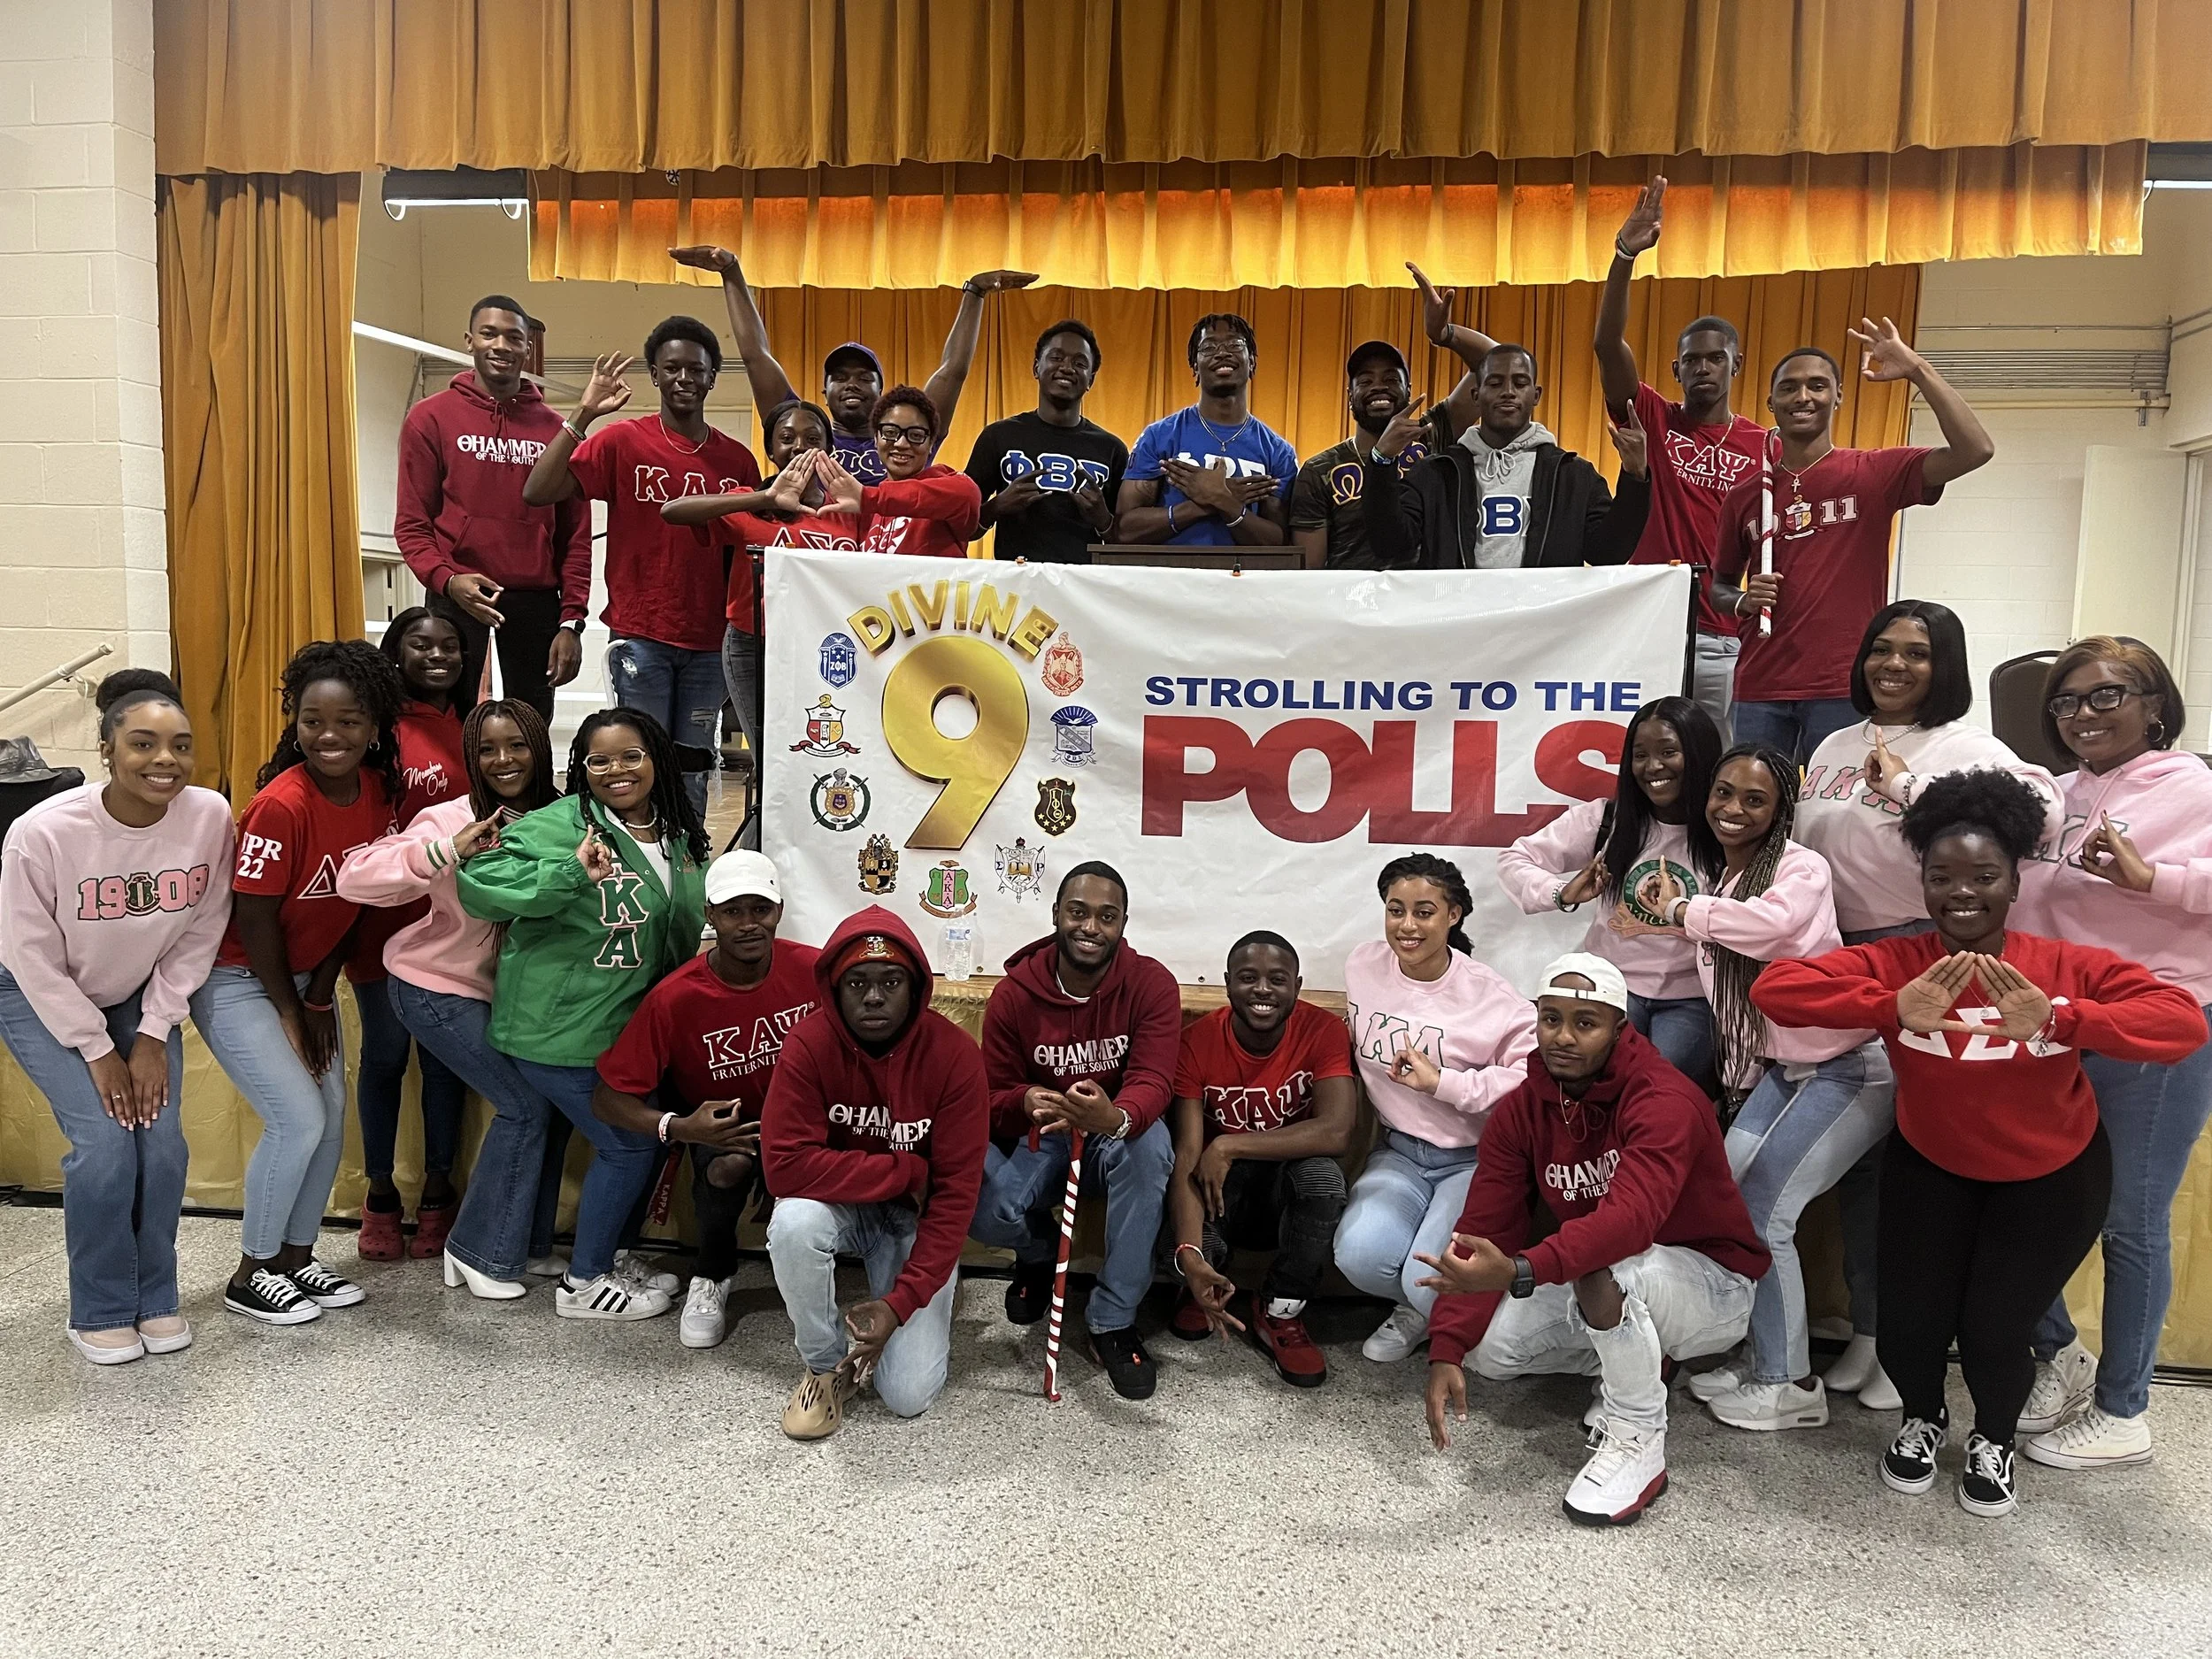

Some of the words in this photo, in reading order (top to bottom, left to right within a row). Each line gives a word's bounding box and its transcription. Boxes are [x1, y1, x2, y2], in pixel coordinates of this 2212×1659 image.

[489, 453, 506, 463] THE
[847, 580, 1060, 661] DIVINE
[1144, 676, 1432, 710] STROLLING
[1450, 681, 1517, 711] TO
[1534, 681, 1642, 713] THE
[880, 634, 1030, 852] 9
[1141, 715, 1628, 848] POLLS
[237, 855, 265, 879] 22
[711, 1052, 781, 1081] FRATERNIT
[1054, 1066, 1066, 1076] OF
[1069, 1063, 1088, 1075] THE
[1563, 1189, 1578, 1202] OF
[1579, 1184, 1602, 1199] THE
